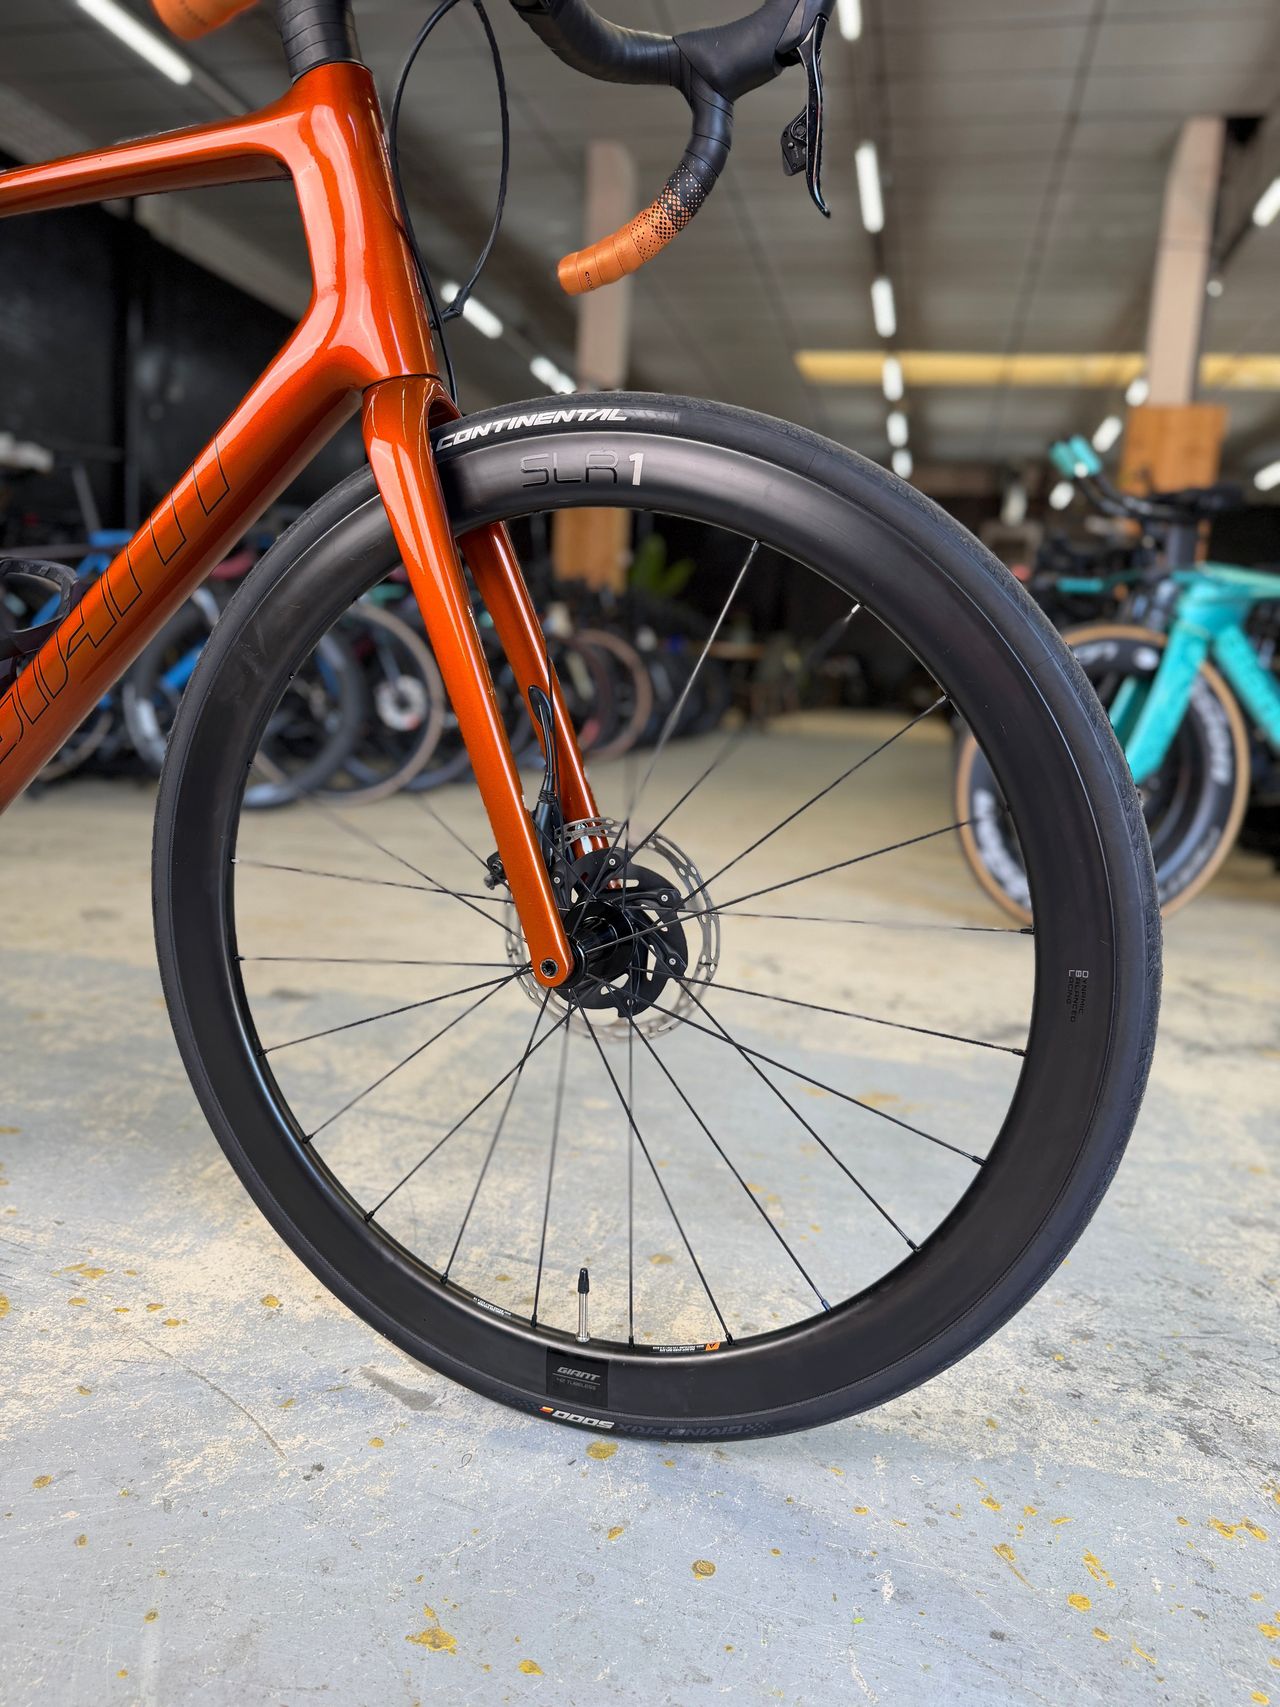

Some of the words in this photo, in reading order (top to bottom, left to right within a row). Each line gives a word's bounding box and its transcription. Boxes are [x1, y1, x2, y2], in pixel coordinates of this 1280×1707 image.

[435, 408, 628, 452] CONTINENTAL
[519, 451, 619, 488] SLR
[628, 452, 645, 486] 1
[556, 1366, 601, 1381] GIANT
[552, 1409, 615, 1430] 5000
